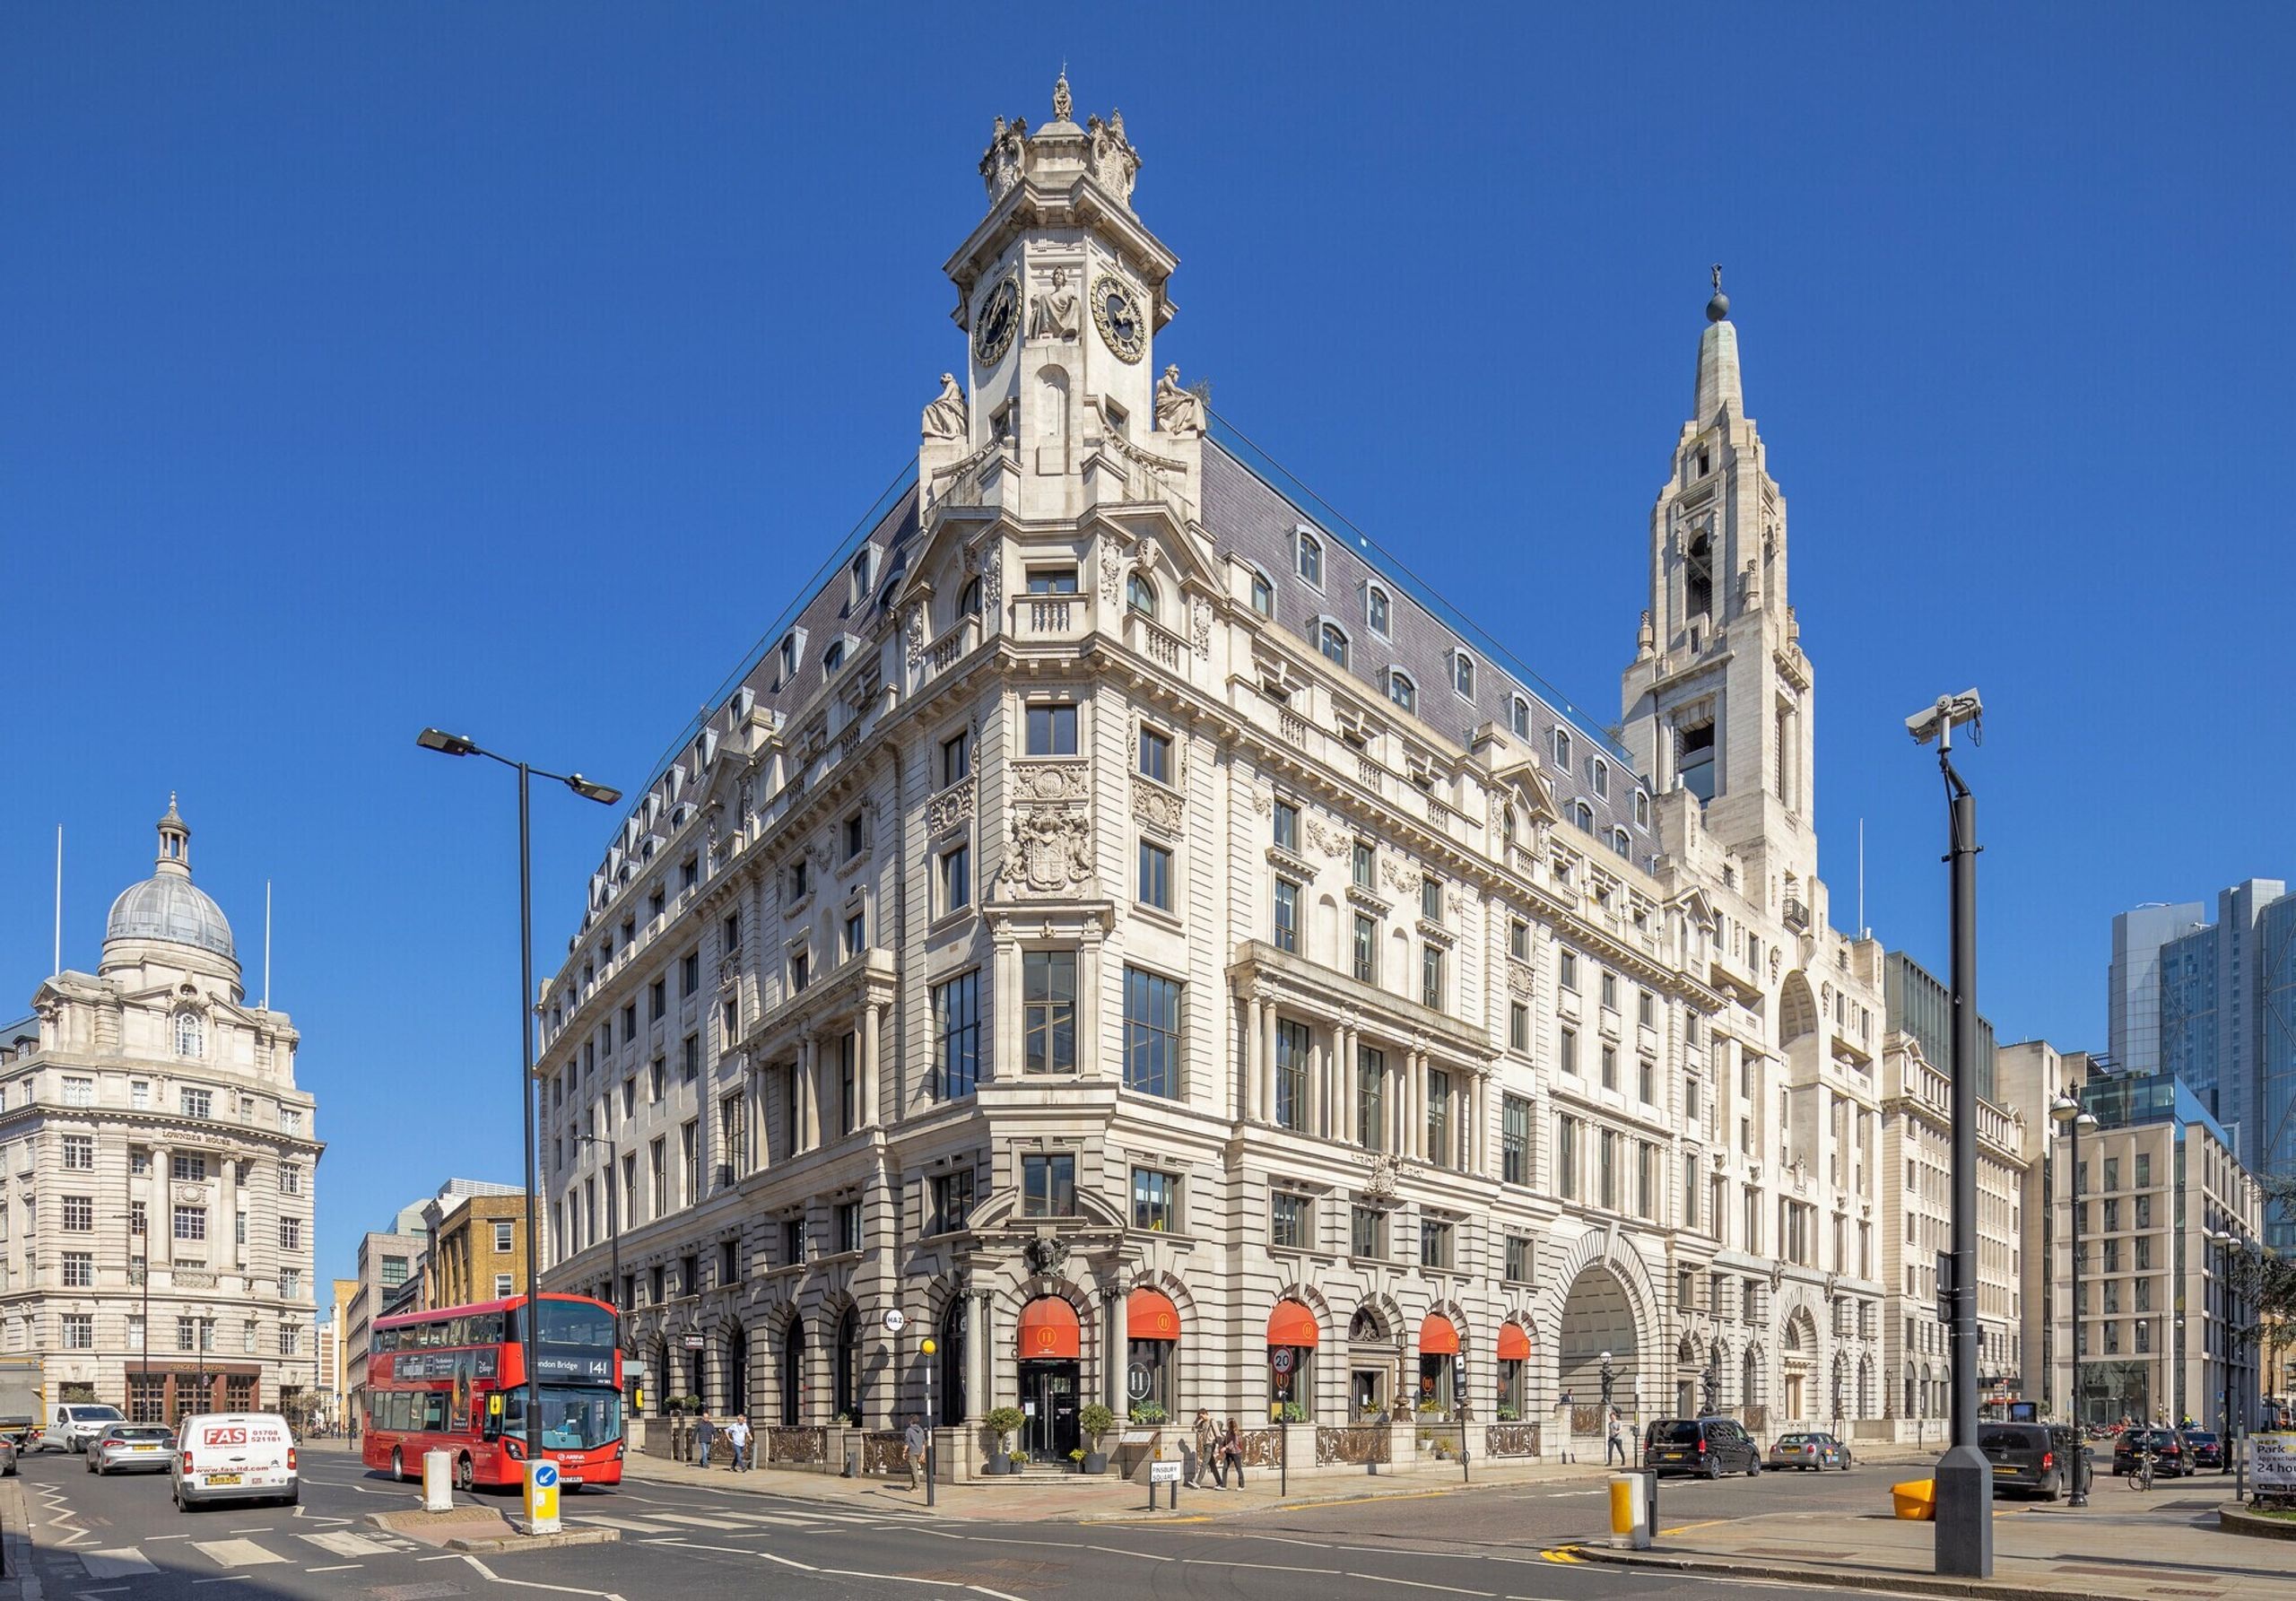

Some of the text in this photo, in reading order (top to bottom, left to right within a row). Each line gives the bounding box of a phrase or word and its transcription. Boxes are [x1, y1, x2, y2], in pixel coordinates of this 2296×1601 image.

[162, 1131, 230, 1146] LOWNDES HOUSE
[1275, 1355, 1290, 1366] 20
[557, 1361, 578, 1370] Bridge
[589, 1361, 607, 1375] 141
[205, 1429, 246, 1444] FAS
[196, 1466, 269, 1474] www.fas-ltd.com
[2257, 1464, 2274, 1473] 24
